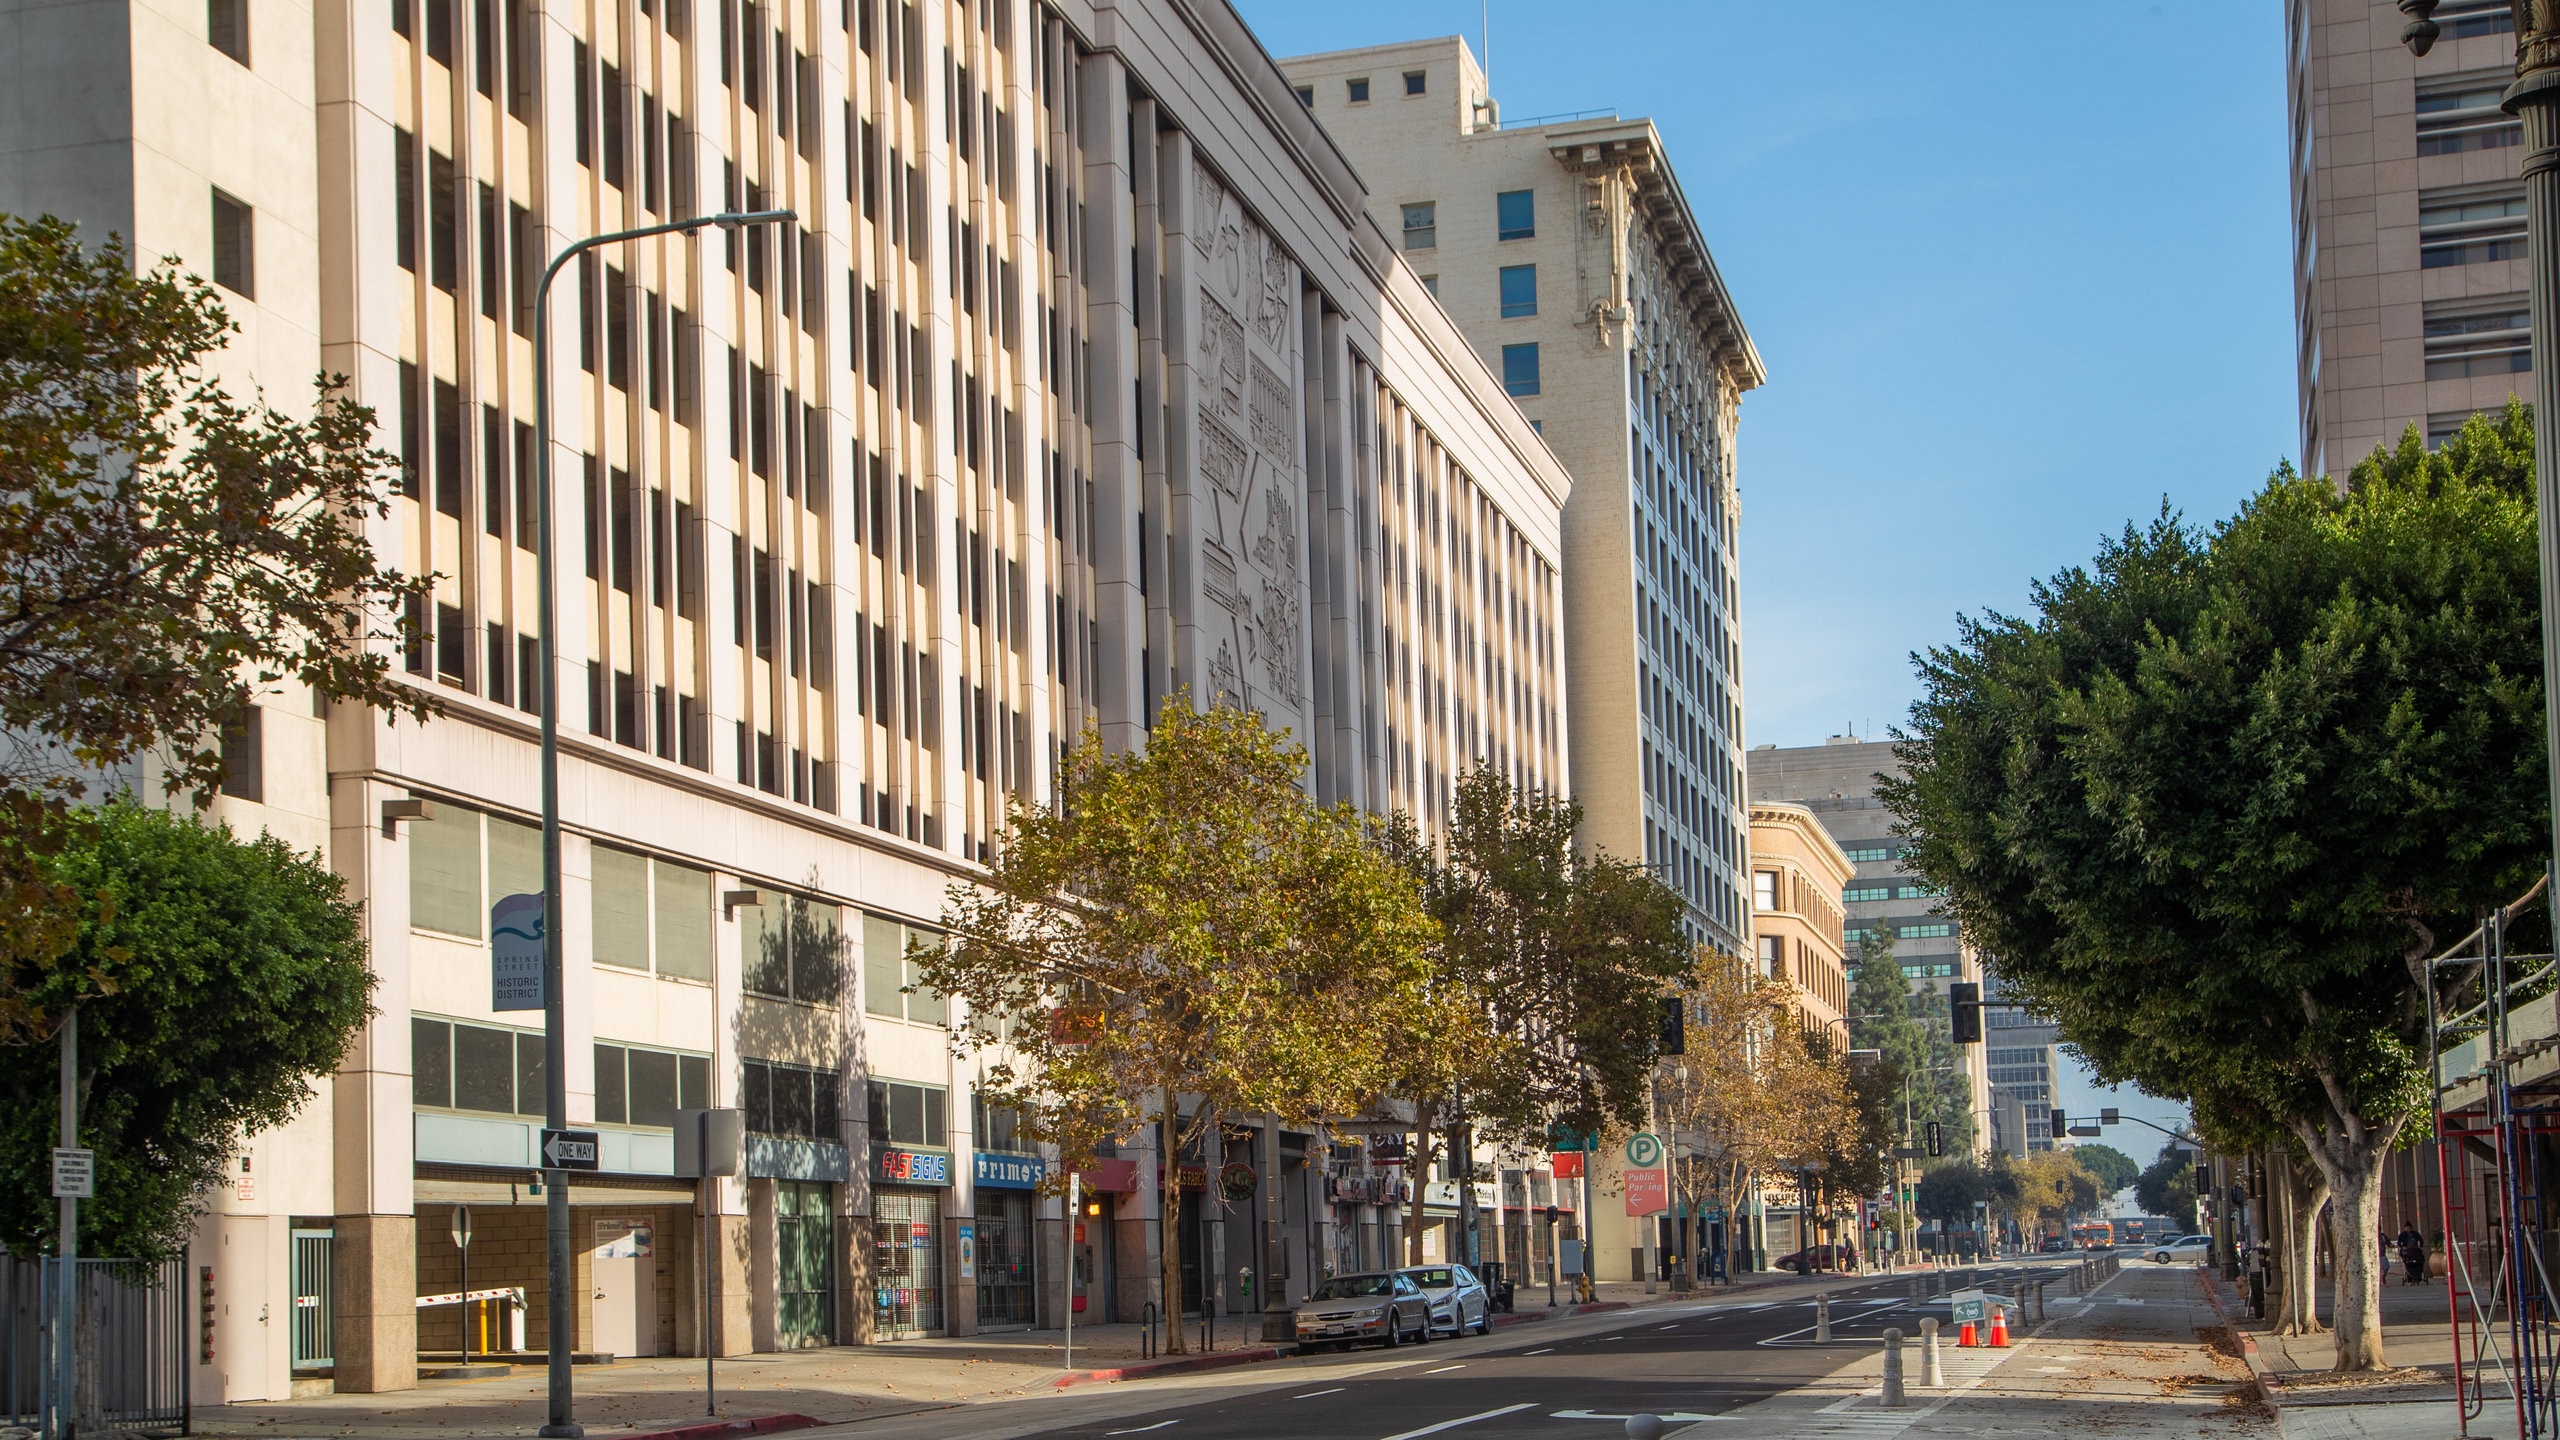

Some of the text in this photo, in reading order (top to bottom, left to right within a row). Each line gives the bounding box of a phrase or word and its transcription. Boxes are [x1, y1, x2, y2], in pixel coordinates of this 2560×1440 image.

[497, 955, 539, 963] SPRING
[497, 963, 539, 971] STREET
[497, 977, 539, 987] HISTORIC
[497, 988, 538, 999] DISTRICT
[558, 1143, 593, 1159] ONE WAY
[1636, 1140, 1651, 1160] P
[882, 1152, 946, 1181] FASTSIGNS
[1628, 1172, 1656, 1181] Public
